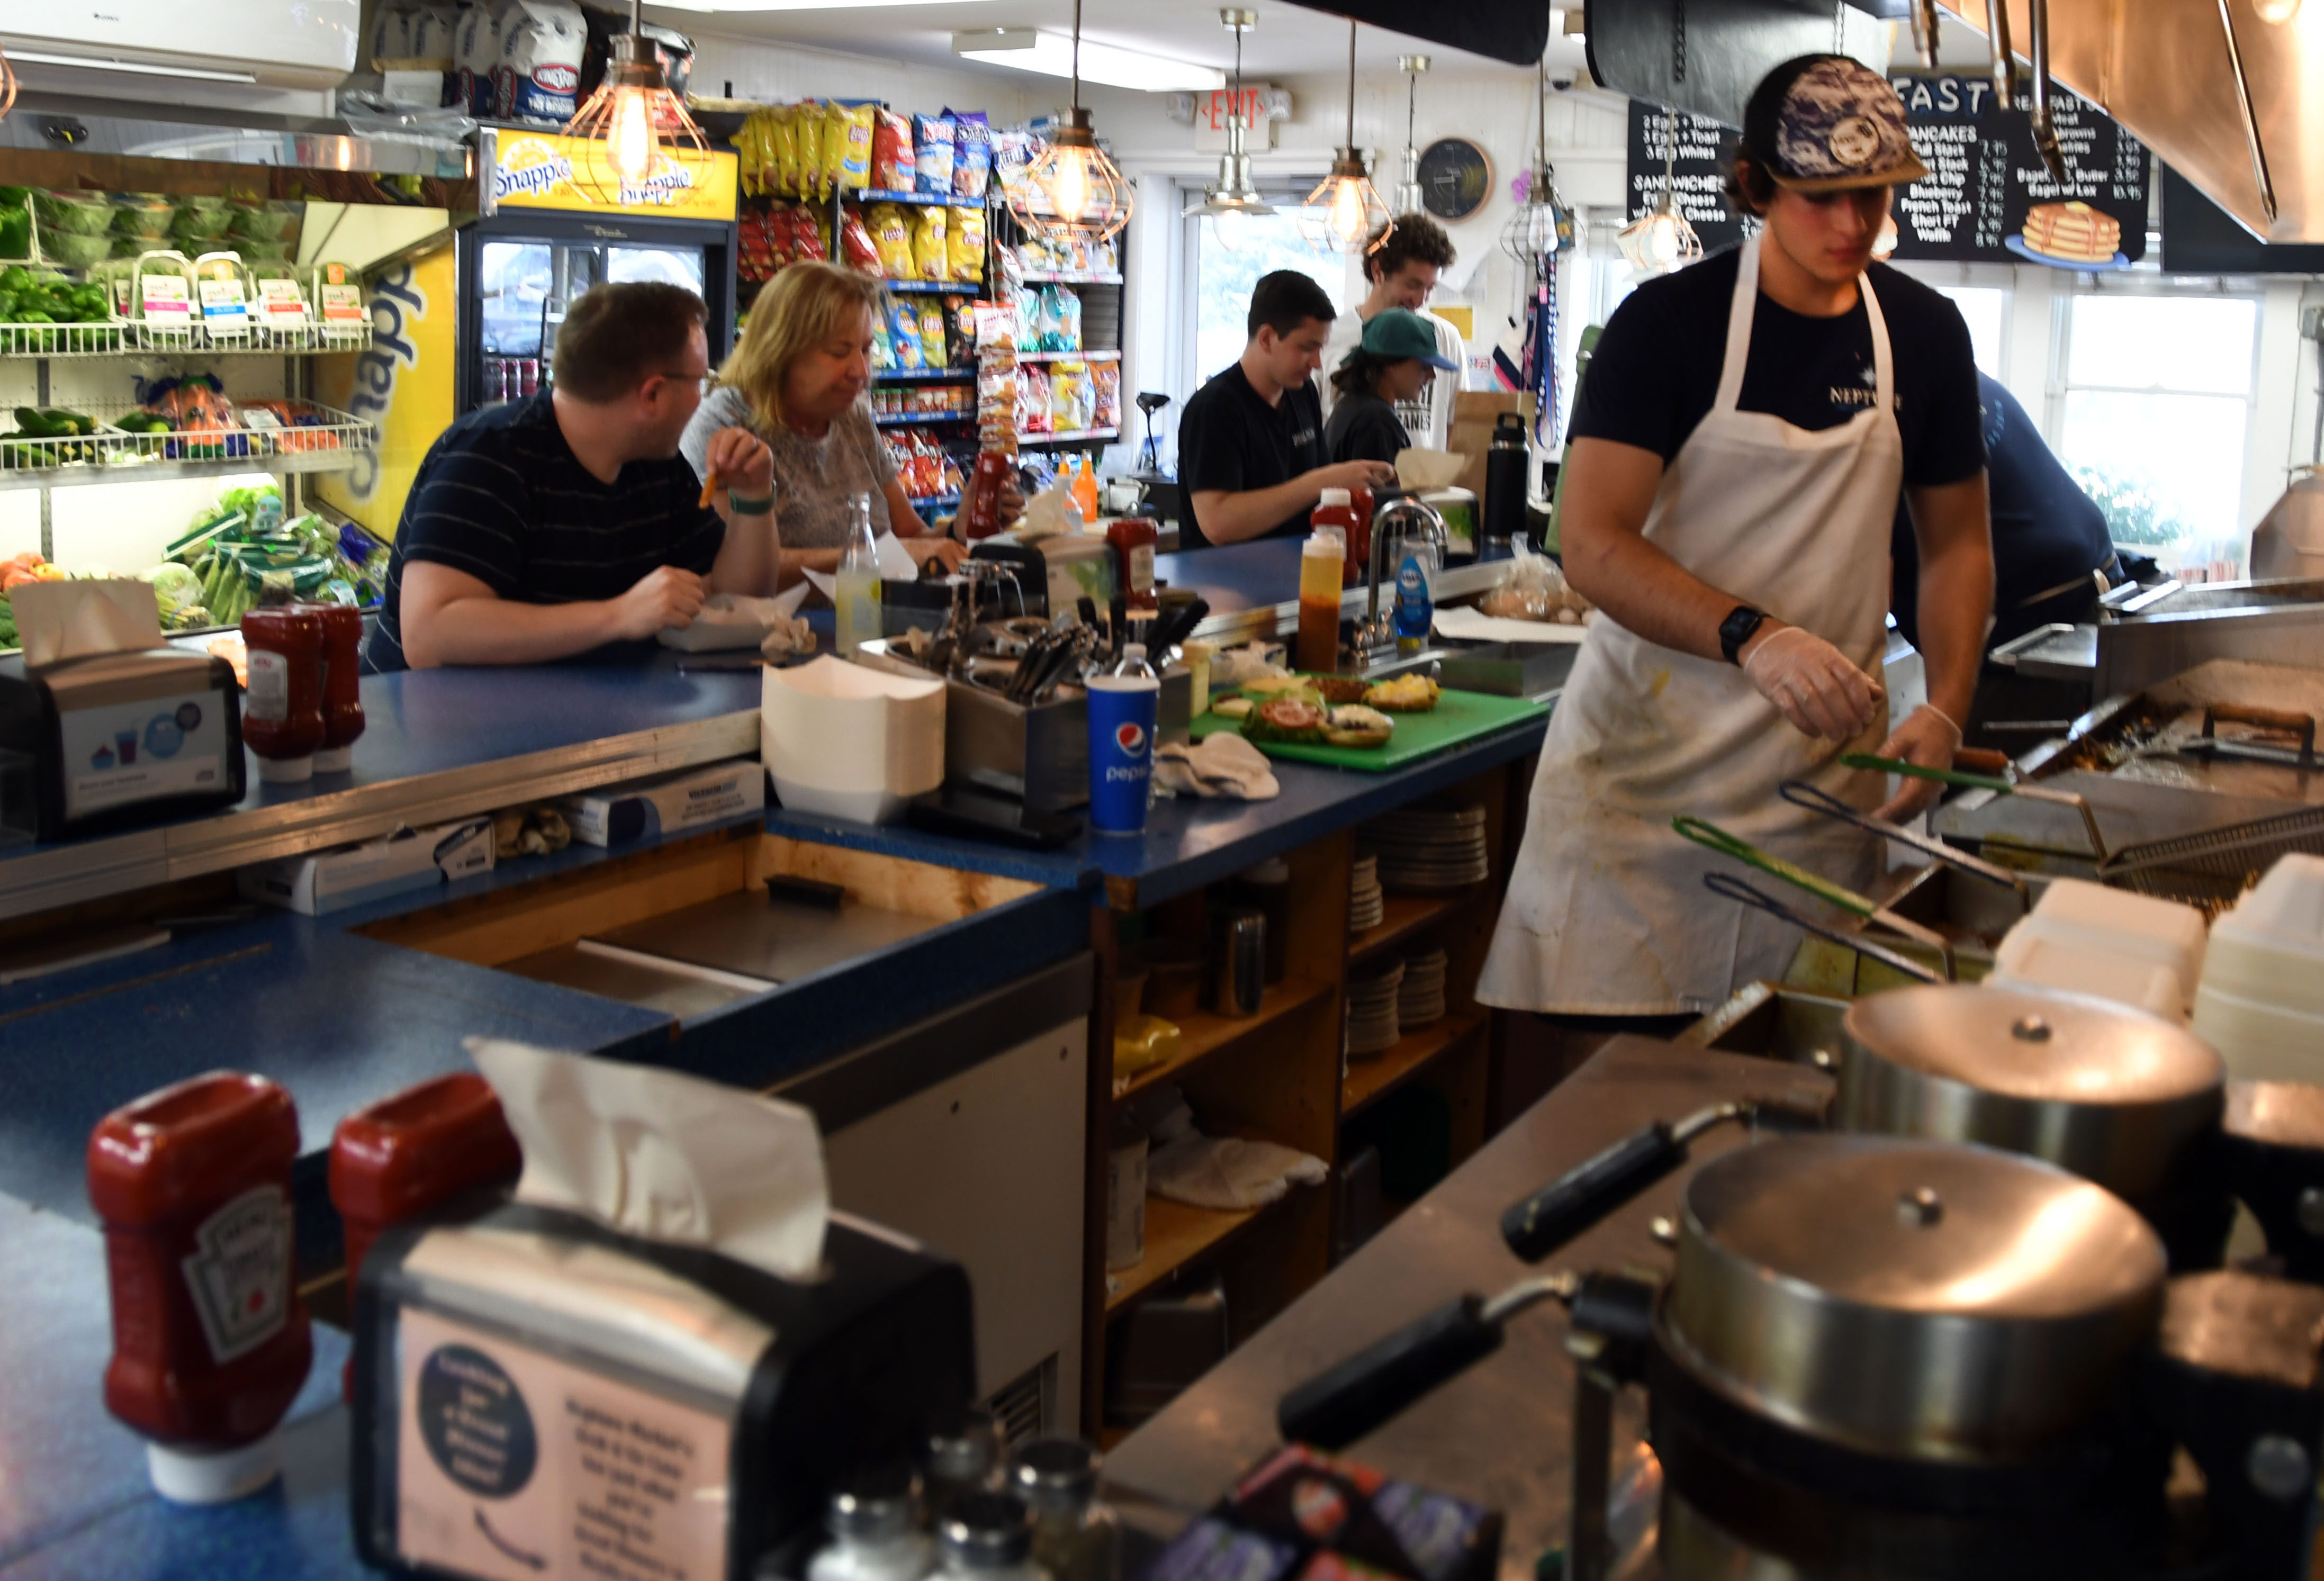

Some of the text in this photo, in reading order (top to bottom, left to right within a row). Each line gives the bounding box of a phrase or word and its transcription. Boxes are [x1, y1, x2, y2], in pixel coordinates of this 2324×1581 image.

[1211, 89, 1259, 130] EXIT
[1690, 129, 1722, 145] Toast
[1934, 141, 1966, 157] Stack
[1938, 156, 1969, 172] Stack
[497, 157, 571, 199] Snapple
[1909, 183, 1963, 202] Blueberry
[2028, 182, 2060, 199] Bagel
[1685, 205, 1726, 222] Cheese
[1900, 197, 1972, 215] French Toast
[1911, 212, 1941, 229] Short
[1916, 226, 1952, 243] Waffle
